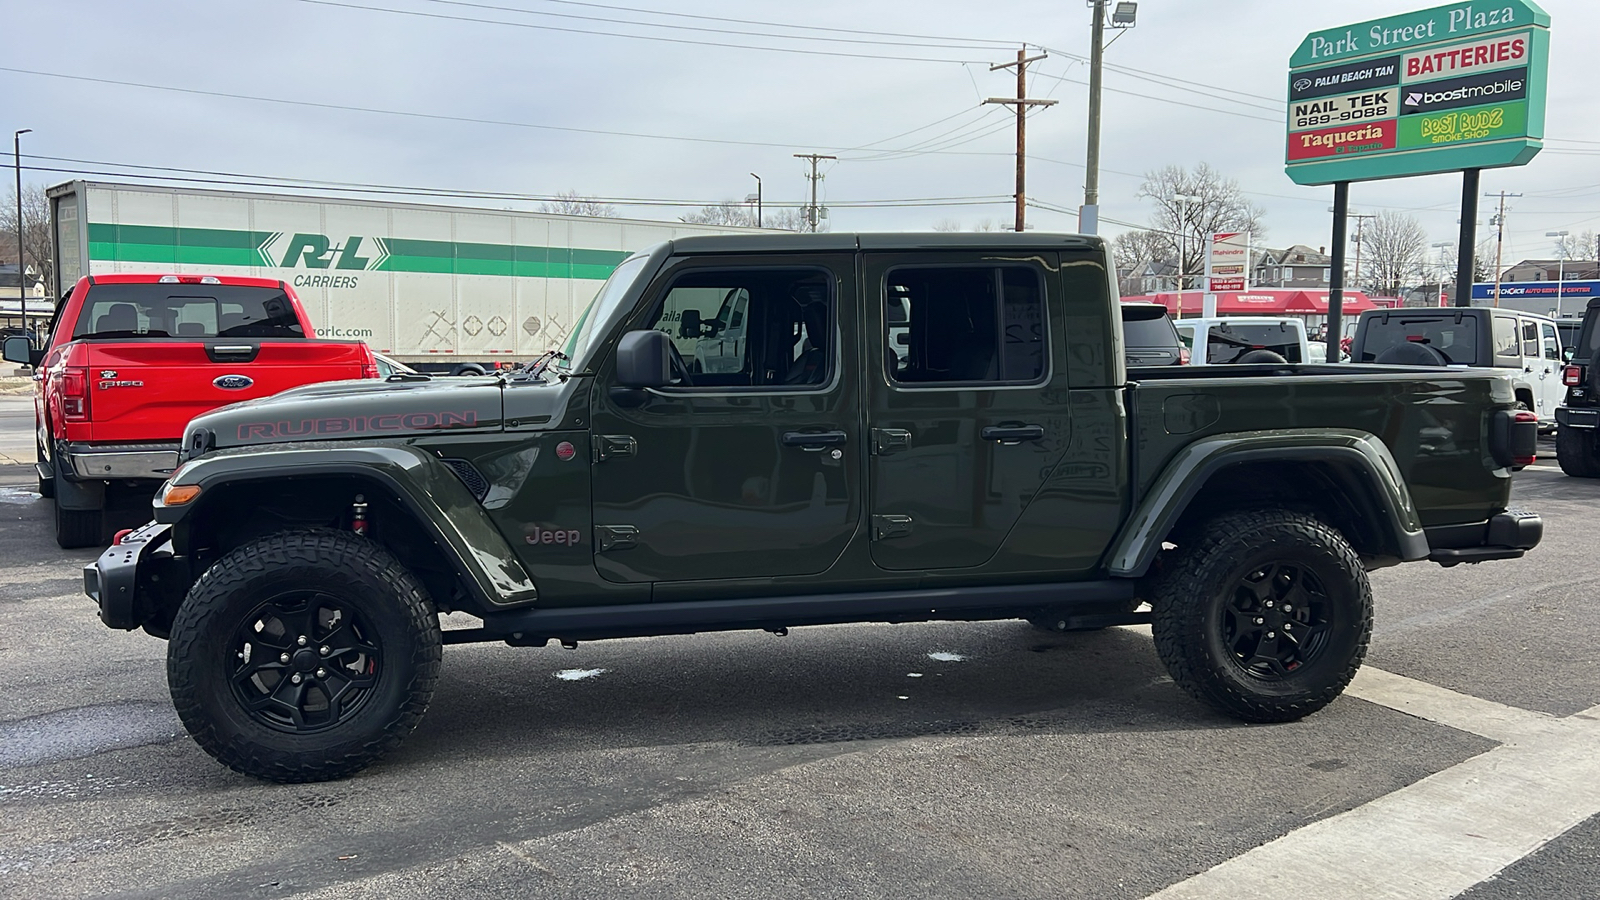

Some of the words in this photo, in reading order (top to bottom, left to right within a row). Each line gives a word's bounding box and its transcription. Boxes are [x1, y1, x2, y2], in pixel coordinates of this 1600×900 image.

[1311, 30, 1359, 58] Park
[1369, 18, 1436, 48] Street
[1448, 5, 1515, 33] Plaza
[1407, 39, 1525, 77] BATTERIES
[1314, 76, 1340, 88] PALM
[1341, 69, 1373, 84] BEACH
[1375, 65, 1395, 78] TAN
[1295, 100, 1339, 117] NAIL
[1347, 92, 1390, 109] TEK
[1297, 106, 1388, 127] 689-9088
[1459, 107, 1504, 133] BUDZ
[1432, 132, 1463, 144] SMOKE
[1464, 129, 1490, 139] SHOP
[294, 275, 359, 289] CARRIERS
[314, 325, 373, 337] orlc.com
[223, 378, 245, 387] Ford
[237, 411, 477, 440] RUBICON
[525, 526, 580, 546] Jeep
